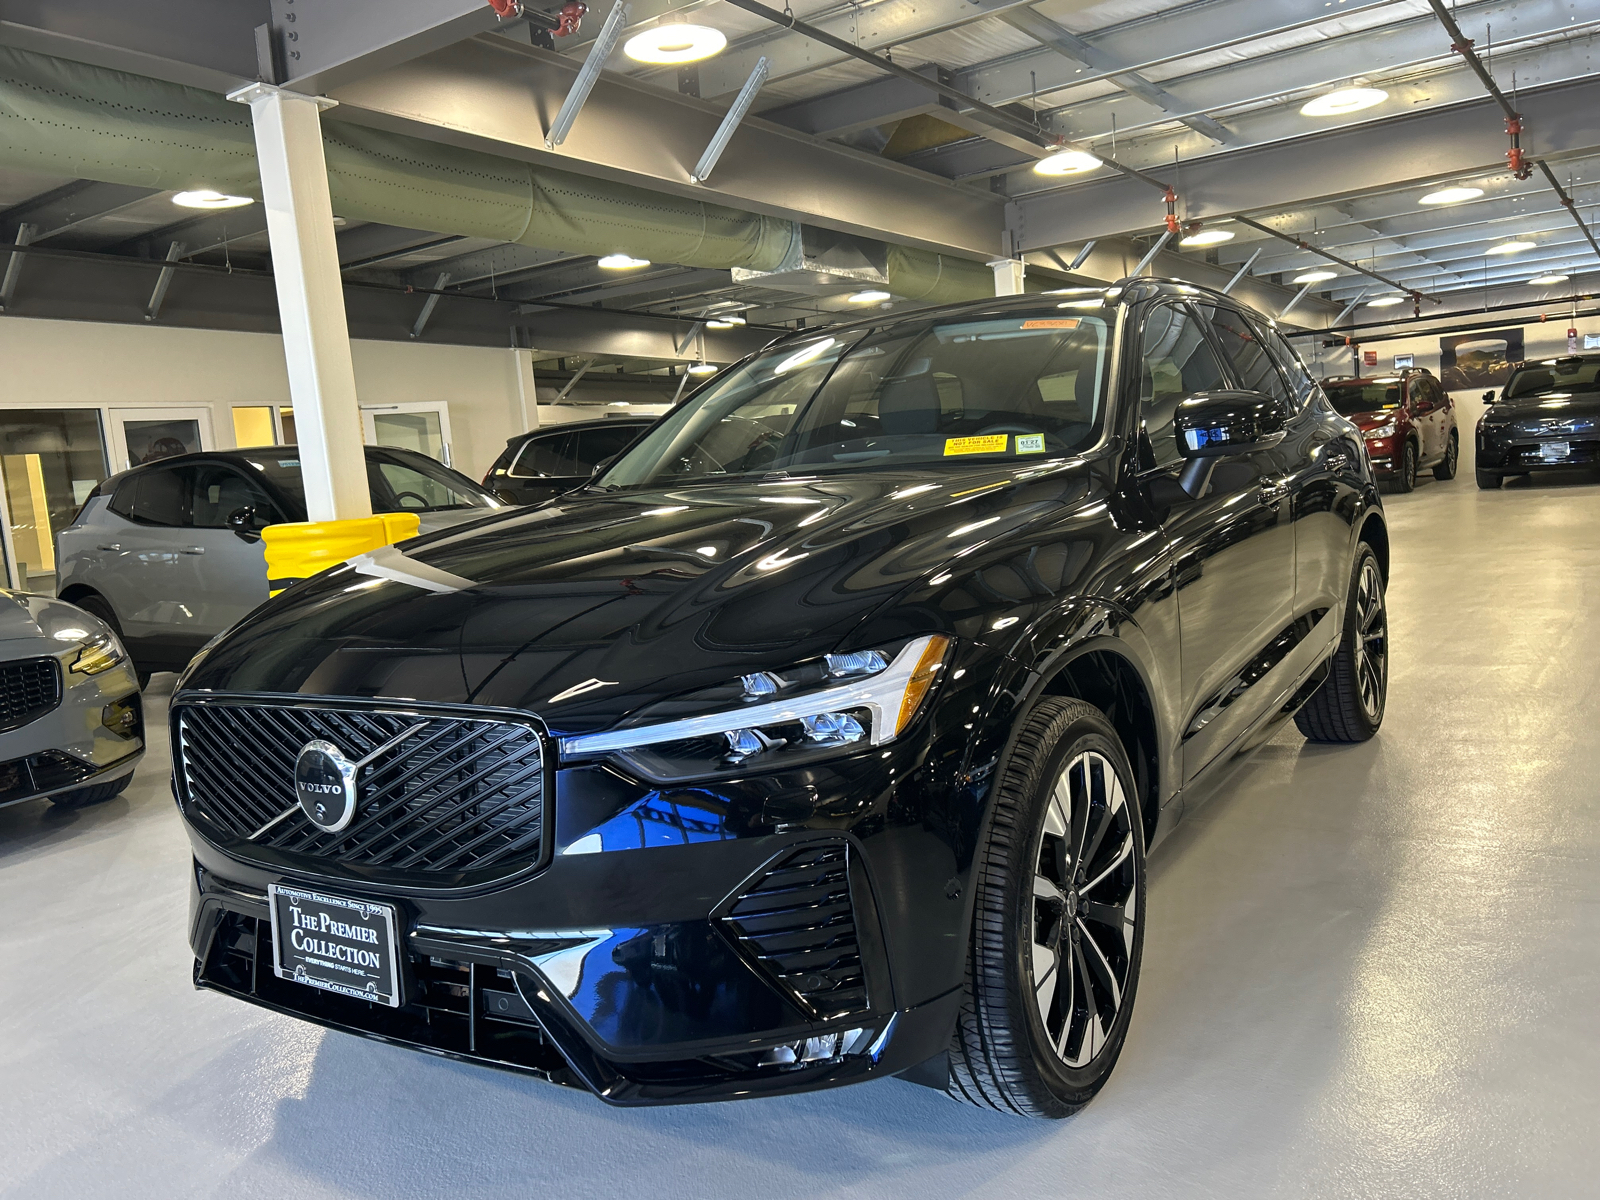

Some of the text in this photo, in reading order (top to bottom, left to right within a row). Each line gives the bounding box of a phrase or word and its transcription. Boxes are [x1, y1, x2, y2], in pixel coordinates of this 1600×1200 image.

[298, 781, 342, 795] VOLVO
[277, 887, 312, 900] AUTOMOTIVE
[312, 893, 347, 907] EXCELLENCE
[348, 900, 366, 911] SINCE
[289, 906, 379, 945] THE PREMIER
[291, 928, 380, 969] COLLECTION
[305, 956, 335, 969] EVERYTHING
[334, 963, 352, 974] STARTS
